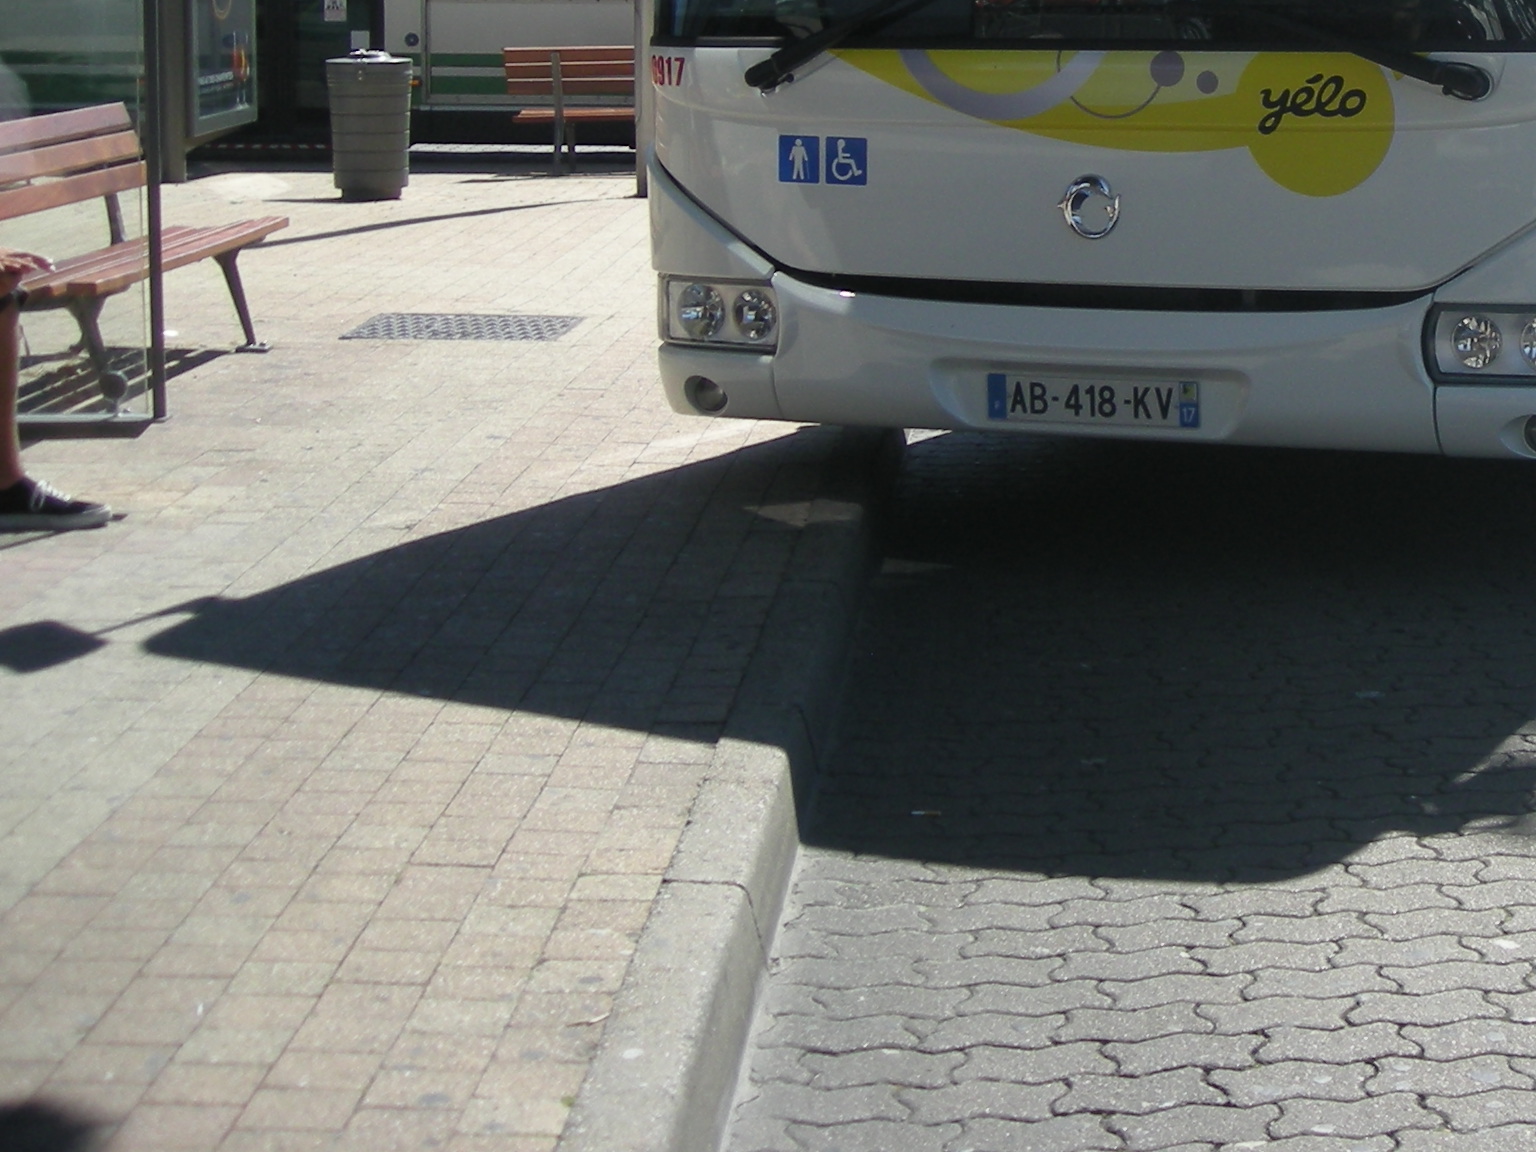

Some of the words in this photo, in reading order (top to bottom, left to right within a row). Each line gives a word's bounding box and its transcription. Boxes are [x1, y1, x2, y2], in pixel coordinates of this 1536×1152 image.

[1258, 73, 1367, 135] yélo
[1010, 381, 1173, 421] AB-418-KV
[1181, 406, 1195, 423] 17
